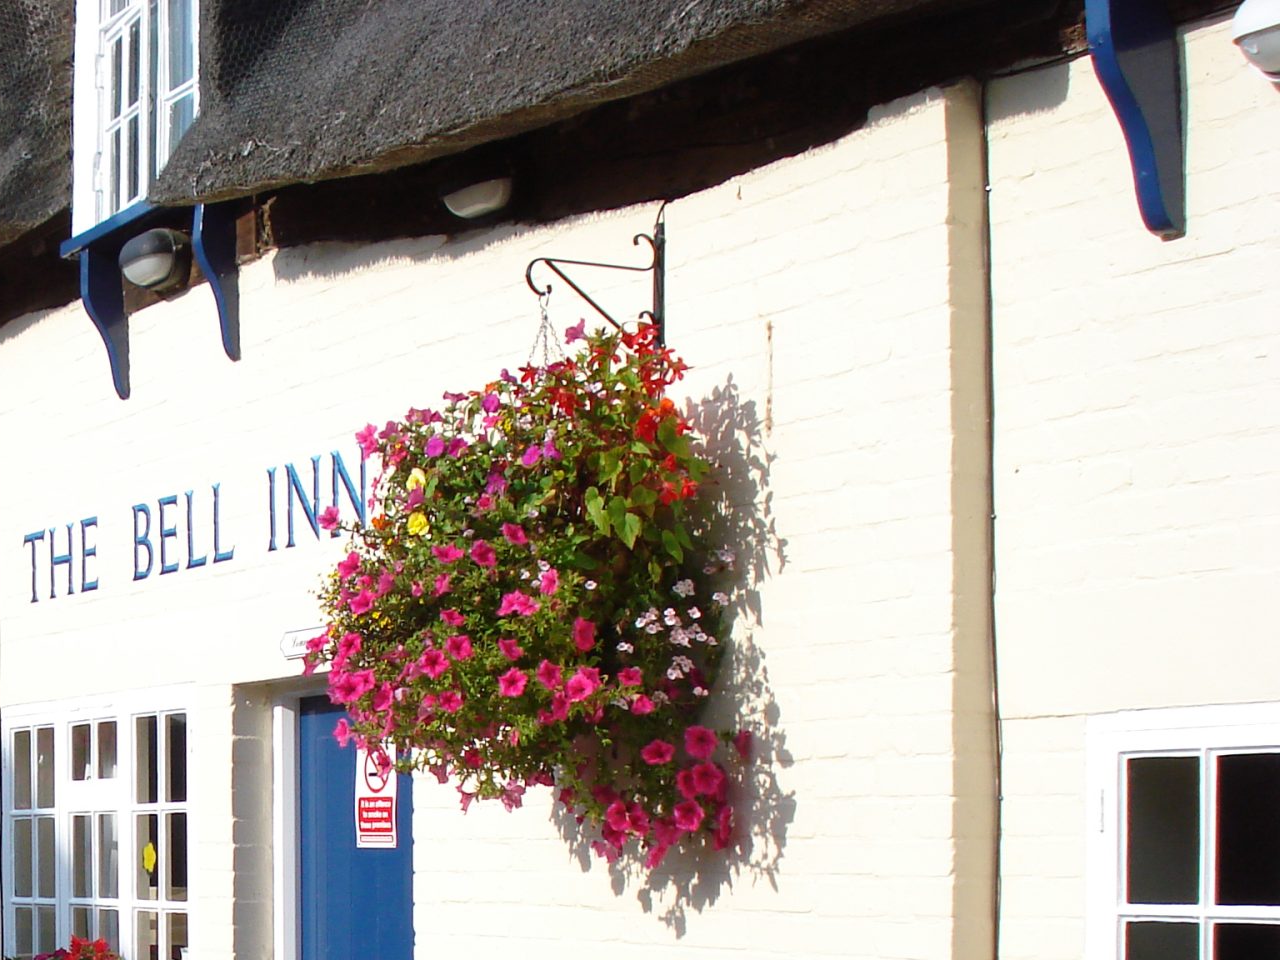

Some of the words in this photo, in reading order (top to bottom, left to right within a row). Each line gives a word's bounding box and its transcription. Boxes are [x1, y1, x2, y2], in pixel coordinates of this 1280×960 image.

[23, 516, 100, 602] THE
[131, 481, 236, 582] BELL
[266, 445, 367, 552] INN
